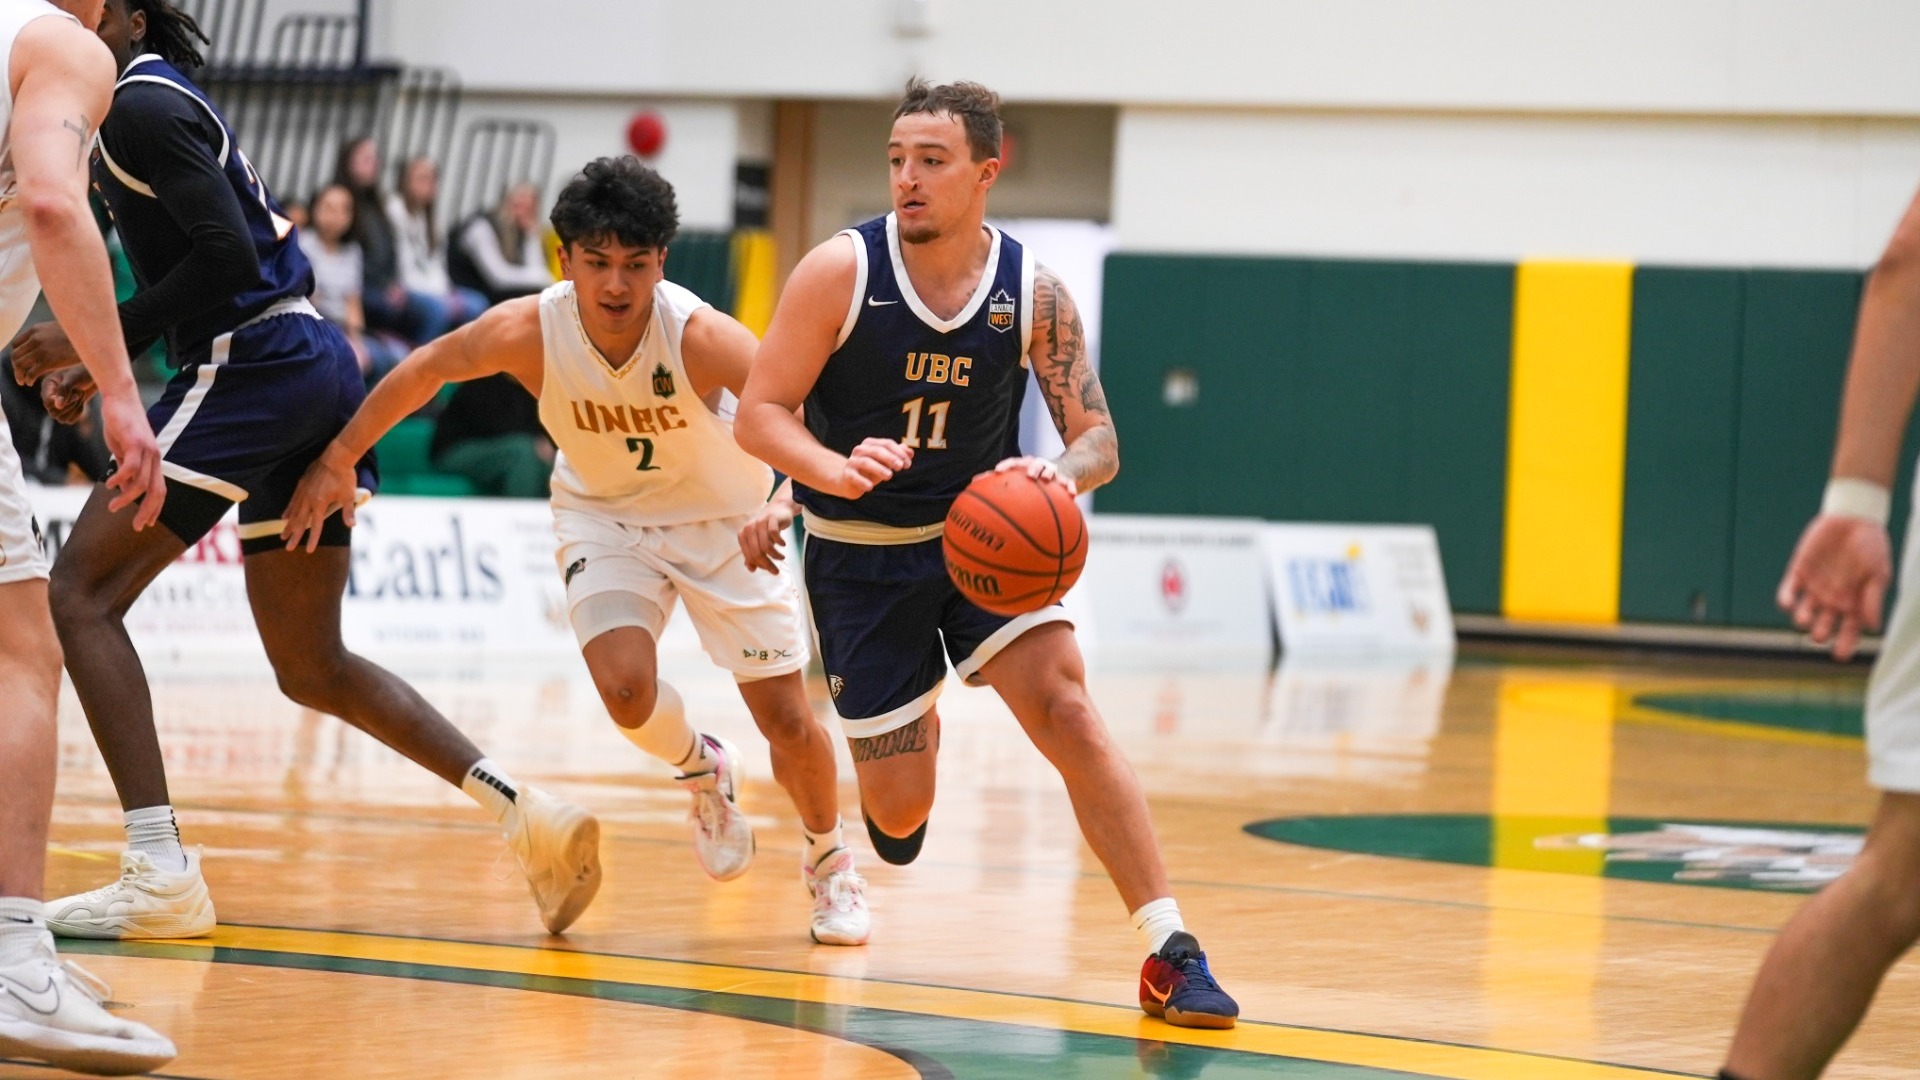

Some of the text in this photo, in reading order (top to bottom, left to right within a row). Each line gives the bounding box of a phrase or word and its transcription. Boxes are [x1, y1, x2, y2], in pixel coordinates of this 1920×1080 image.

[991, 313, 1013, 325] WEST
[905, 352, 973, 388] UBC
[570, 399, 688, 437] UNBC
[901, 396, 951, 450] 11
[625, 437, 662, 471] 2
[347, 512, 505, 604] Earls
